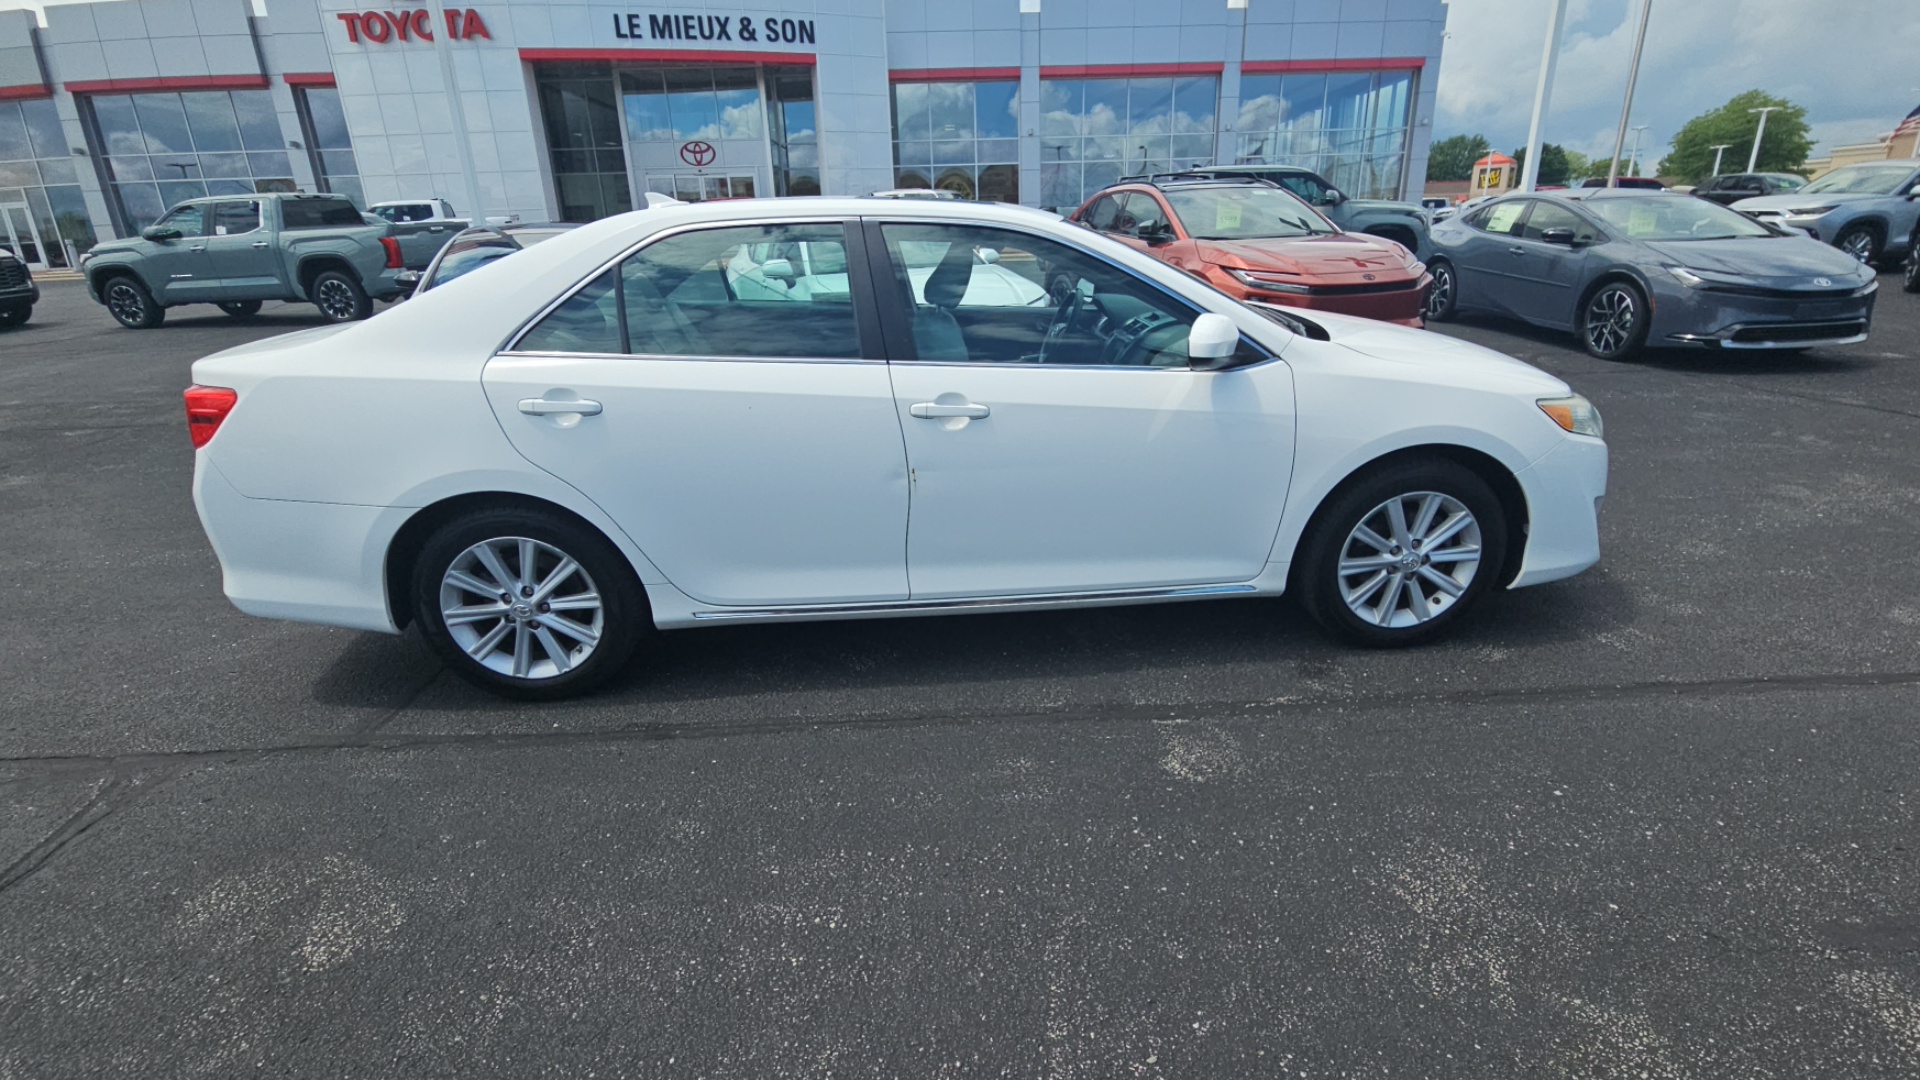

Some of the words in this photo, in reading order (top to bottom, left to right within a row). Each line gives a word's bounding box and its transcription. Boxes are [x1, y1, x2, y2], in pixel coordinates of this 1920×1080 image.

[613, 13, 643, 39] LE
[649, 14, 732, 41] MIEUX
[738, 16, 758, 42] &
[765, 17, 816, 44] SON
